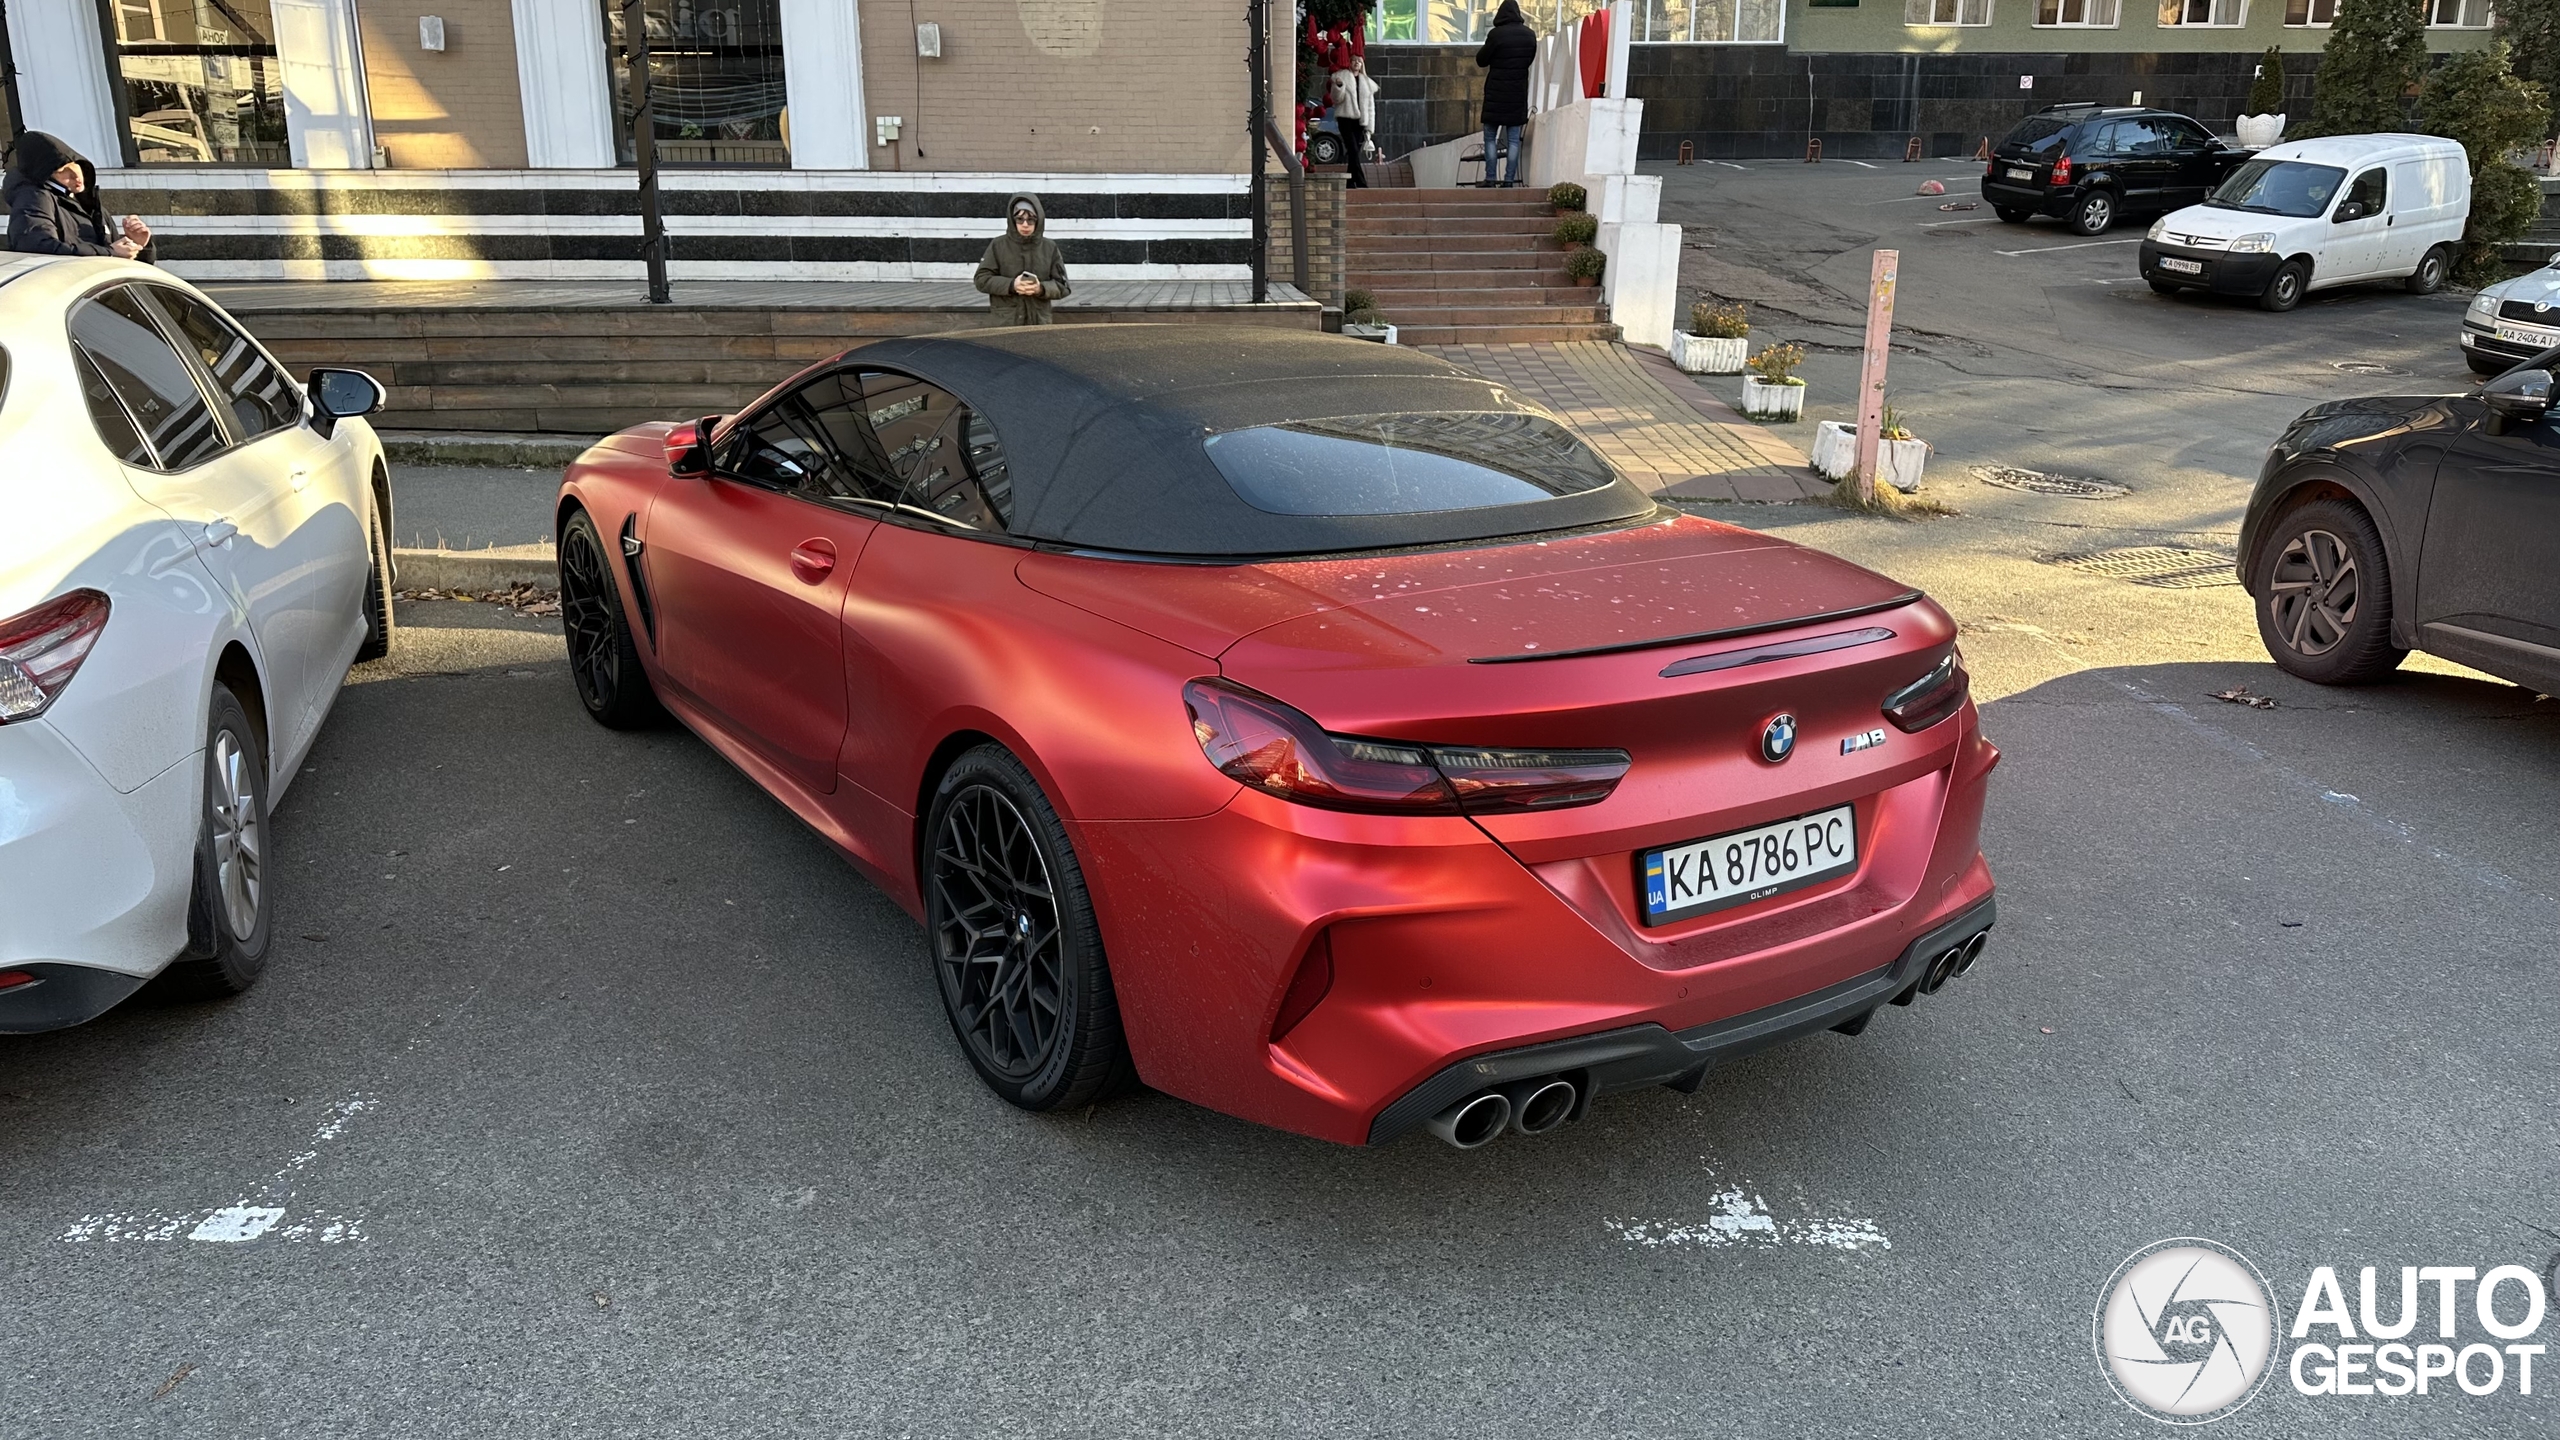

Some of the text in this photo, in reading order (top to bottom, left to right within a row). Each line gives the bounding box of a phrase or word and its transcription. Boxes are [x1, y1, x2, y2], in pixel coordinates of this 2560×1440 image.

[2174, 261, 2190, 270] 0998
[2502, 330, 2515, 340] AA
[2516, 332, 2538, 344] 2406
[1768, 716, 1797, 733] BMW
[1856, 728, 1886, 751] M8
[1668, 817, 1845, 902] KA 8786 PC
[1648, 890, 1664, 906] UA
[1750, 887, 1778, 900] OLIMP
